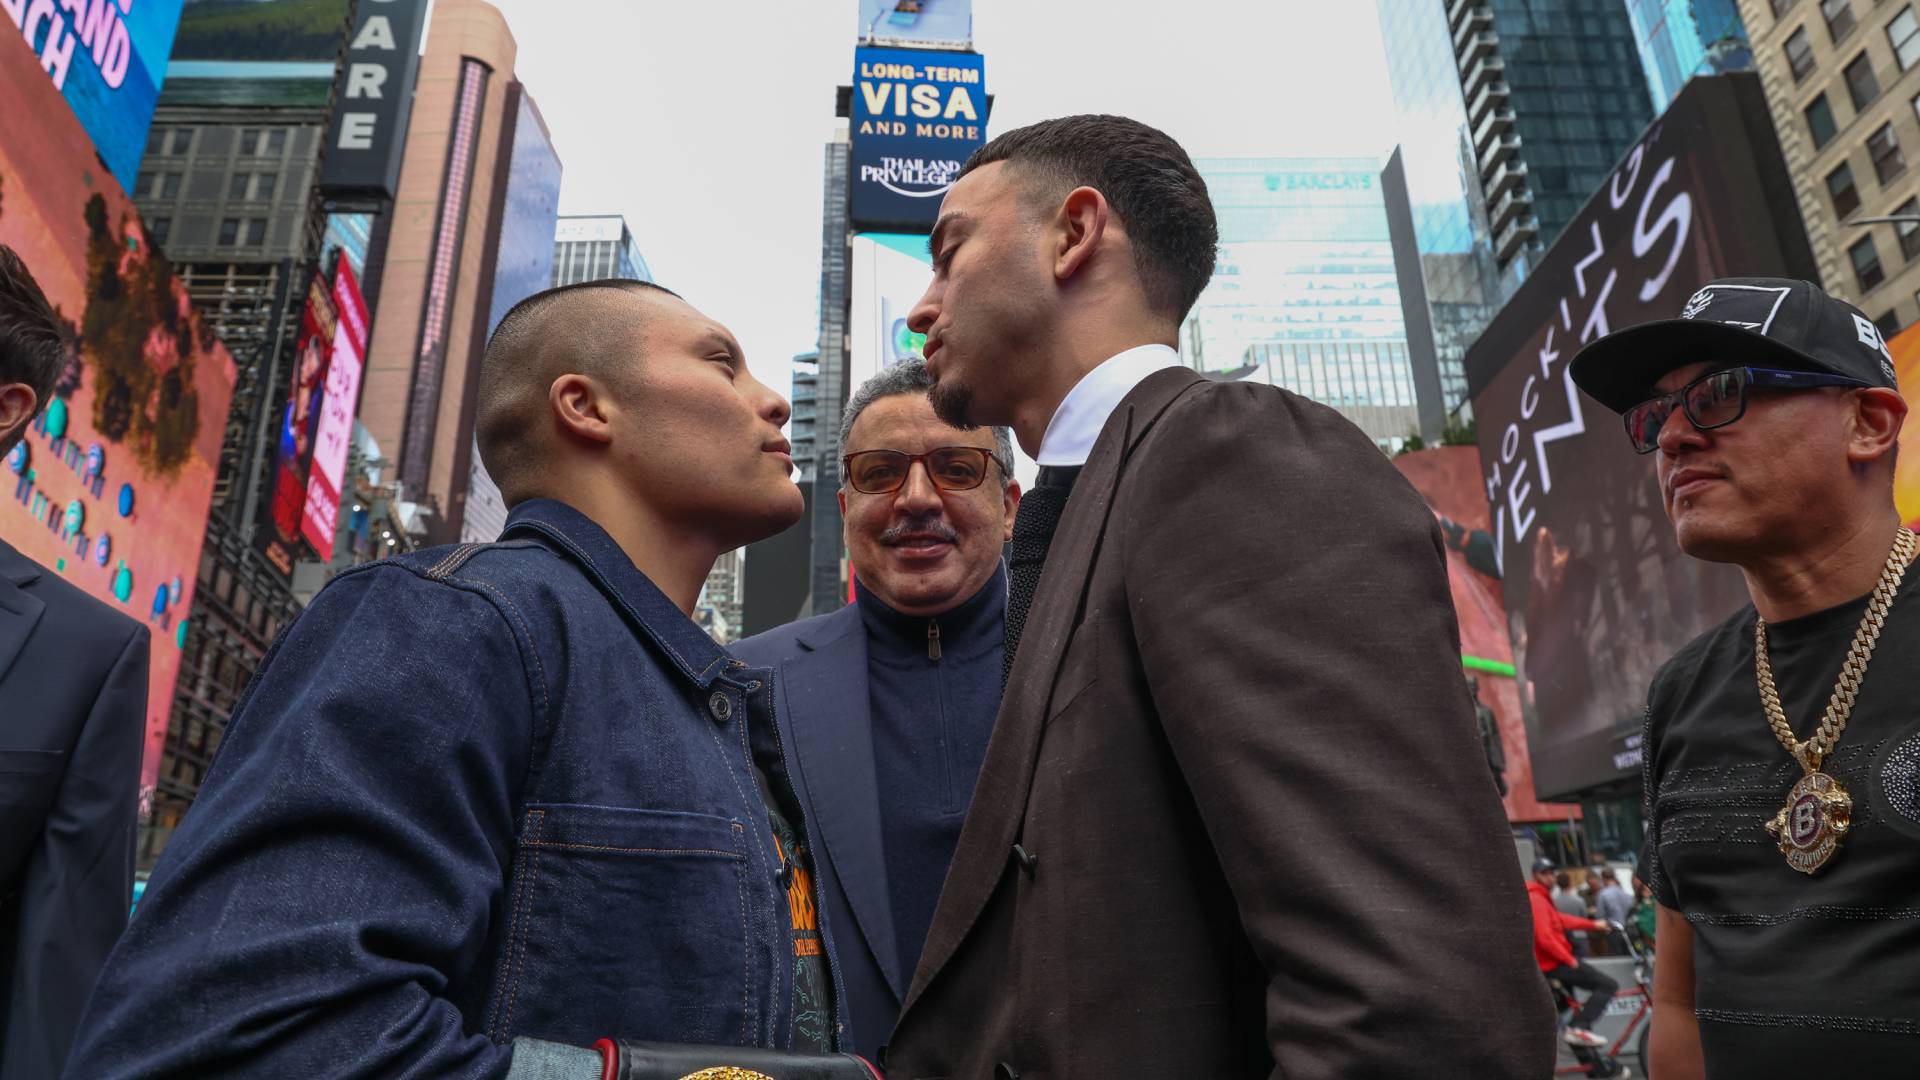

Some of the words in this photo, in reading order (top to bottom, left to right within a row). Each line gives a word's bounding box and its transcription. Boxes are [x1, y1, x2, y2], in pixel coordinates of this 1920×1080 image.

[337, 0, 397, 149] ARE
[861, 62, 979, 84] LONG-TERM
[860, 81, 977, 120] VISA
[860, 120, 906, 136] AND
[916, 123, 979, 140] MORE
[861, 165, 952, 186] PRIVILEGE
[880, 157, 961, 173] THAILAND
[1796, 802, 1816, 839] B
